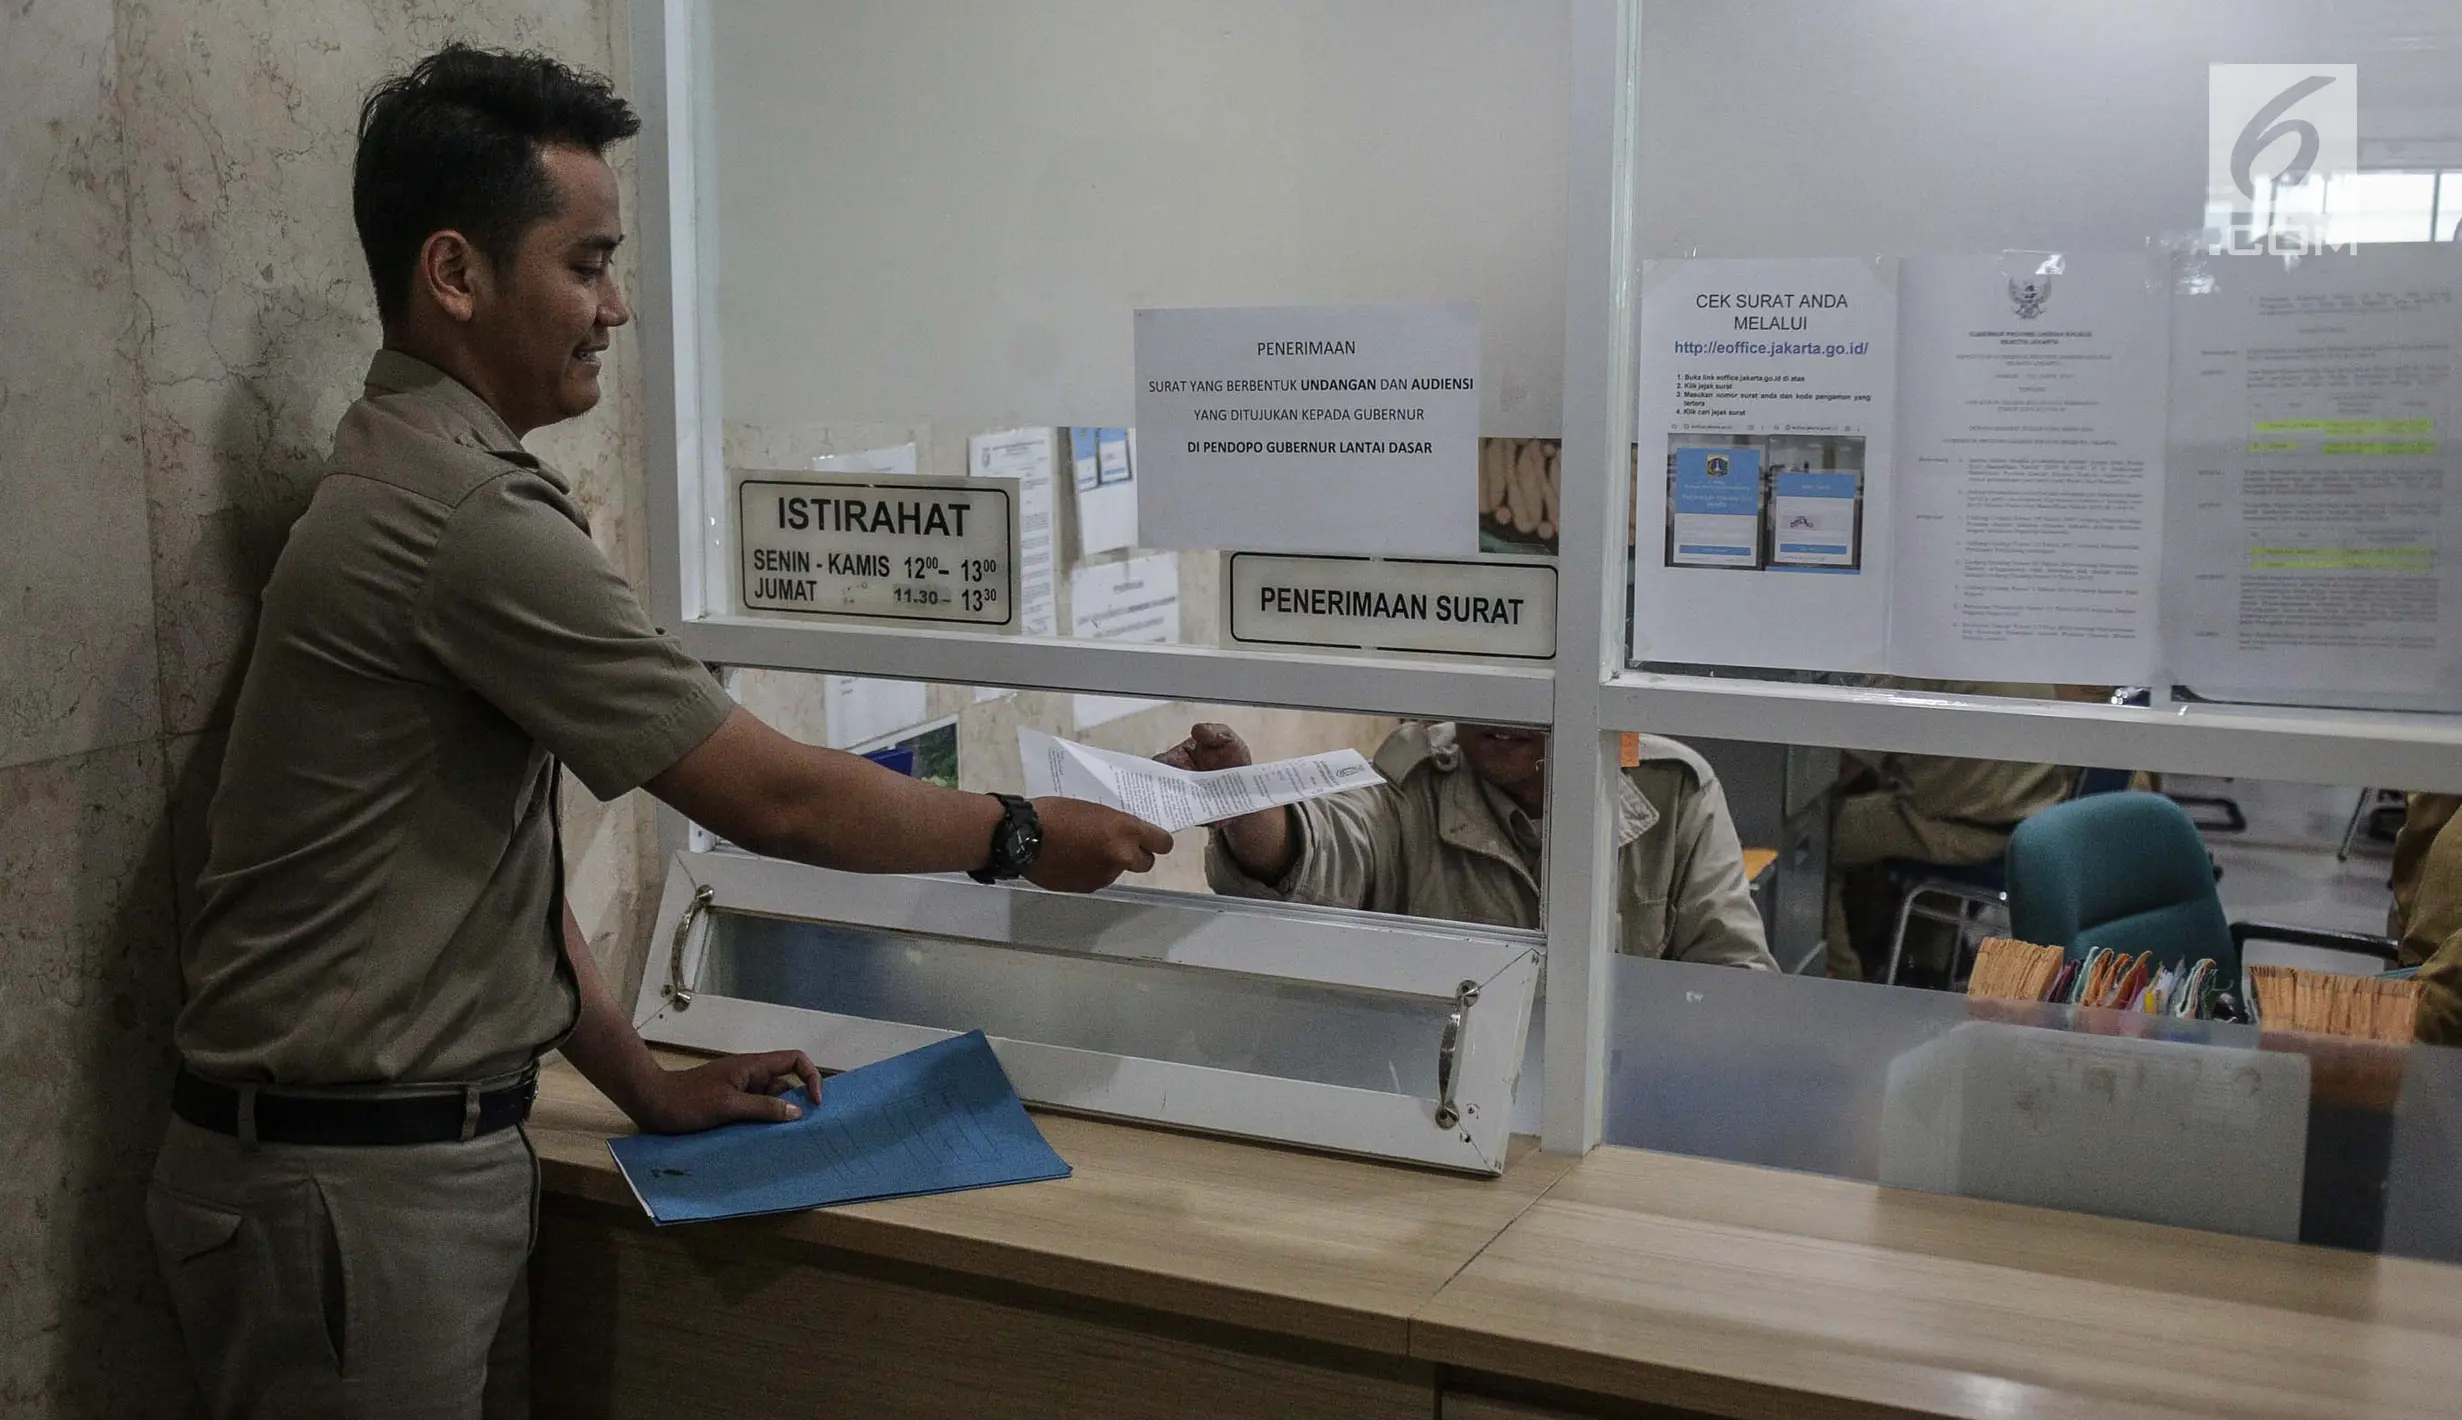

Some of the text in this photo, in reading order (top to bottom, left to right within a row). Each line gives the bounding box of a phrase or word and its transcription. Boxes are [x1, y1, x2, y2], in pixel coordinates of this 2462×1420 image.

[1696, 294, 1848, 308] CEK SURAT ANDA
[1734, 316, 1807, 330] MELALUI
[1258, 341, 1356, 355] PENERIMAAN
[1675, 341, 1869, 358] http://eoffice.jakarta.go.id/
[1148, 378, 1474, 393] SURAT YANG BERBENTUK UNDANGAN DAN AUDIENSI
[1194, 408, 1424, 421] YANG DITUJUKAN KEPADA GUBERNUR
[1187, 442, 1432, 454] DI PENDOPO GUBERNUR LANTAI DASAR
[778, 496, 971, 537] ISTIRAHAT
[754, 549, 810, 573] SENIN
[828, 553, 890, 577] KAMIS
[754, 578, 817, 602] JUMAT
[1260, 586, 1524, 625] PENERIMAAN SURAT
